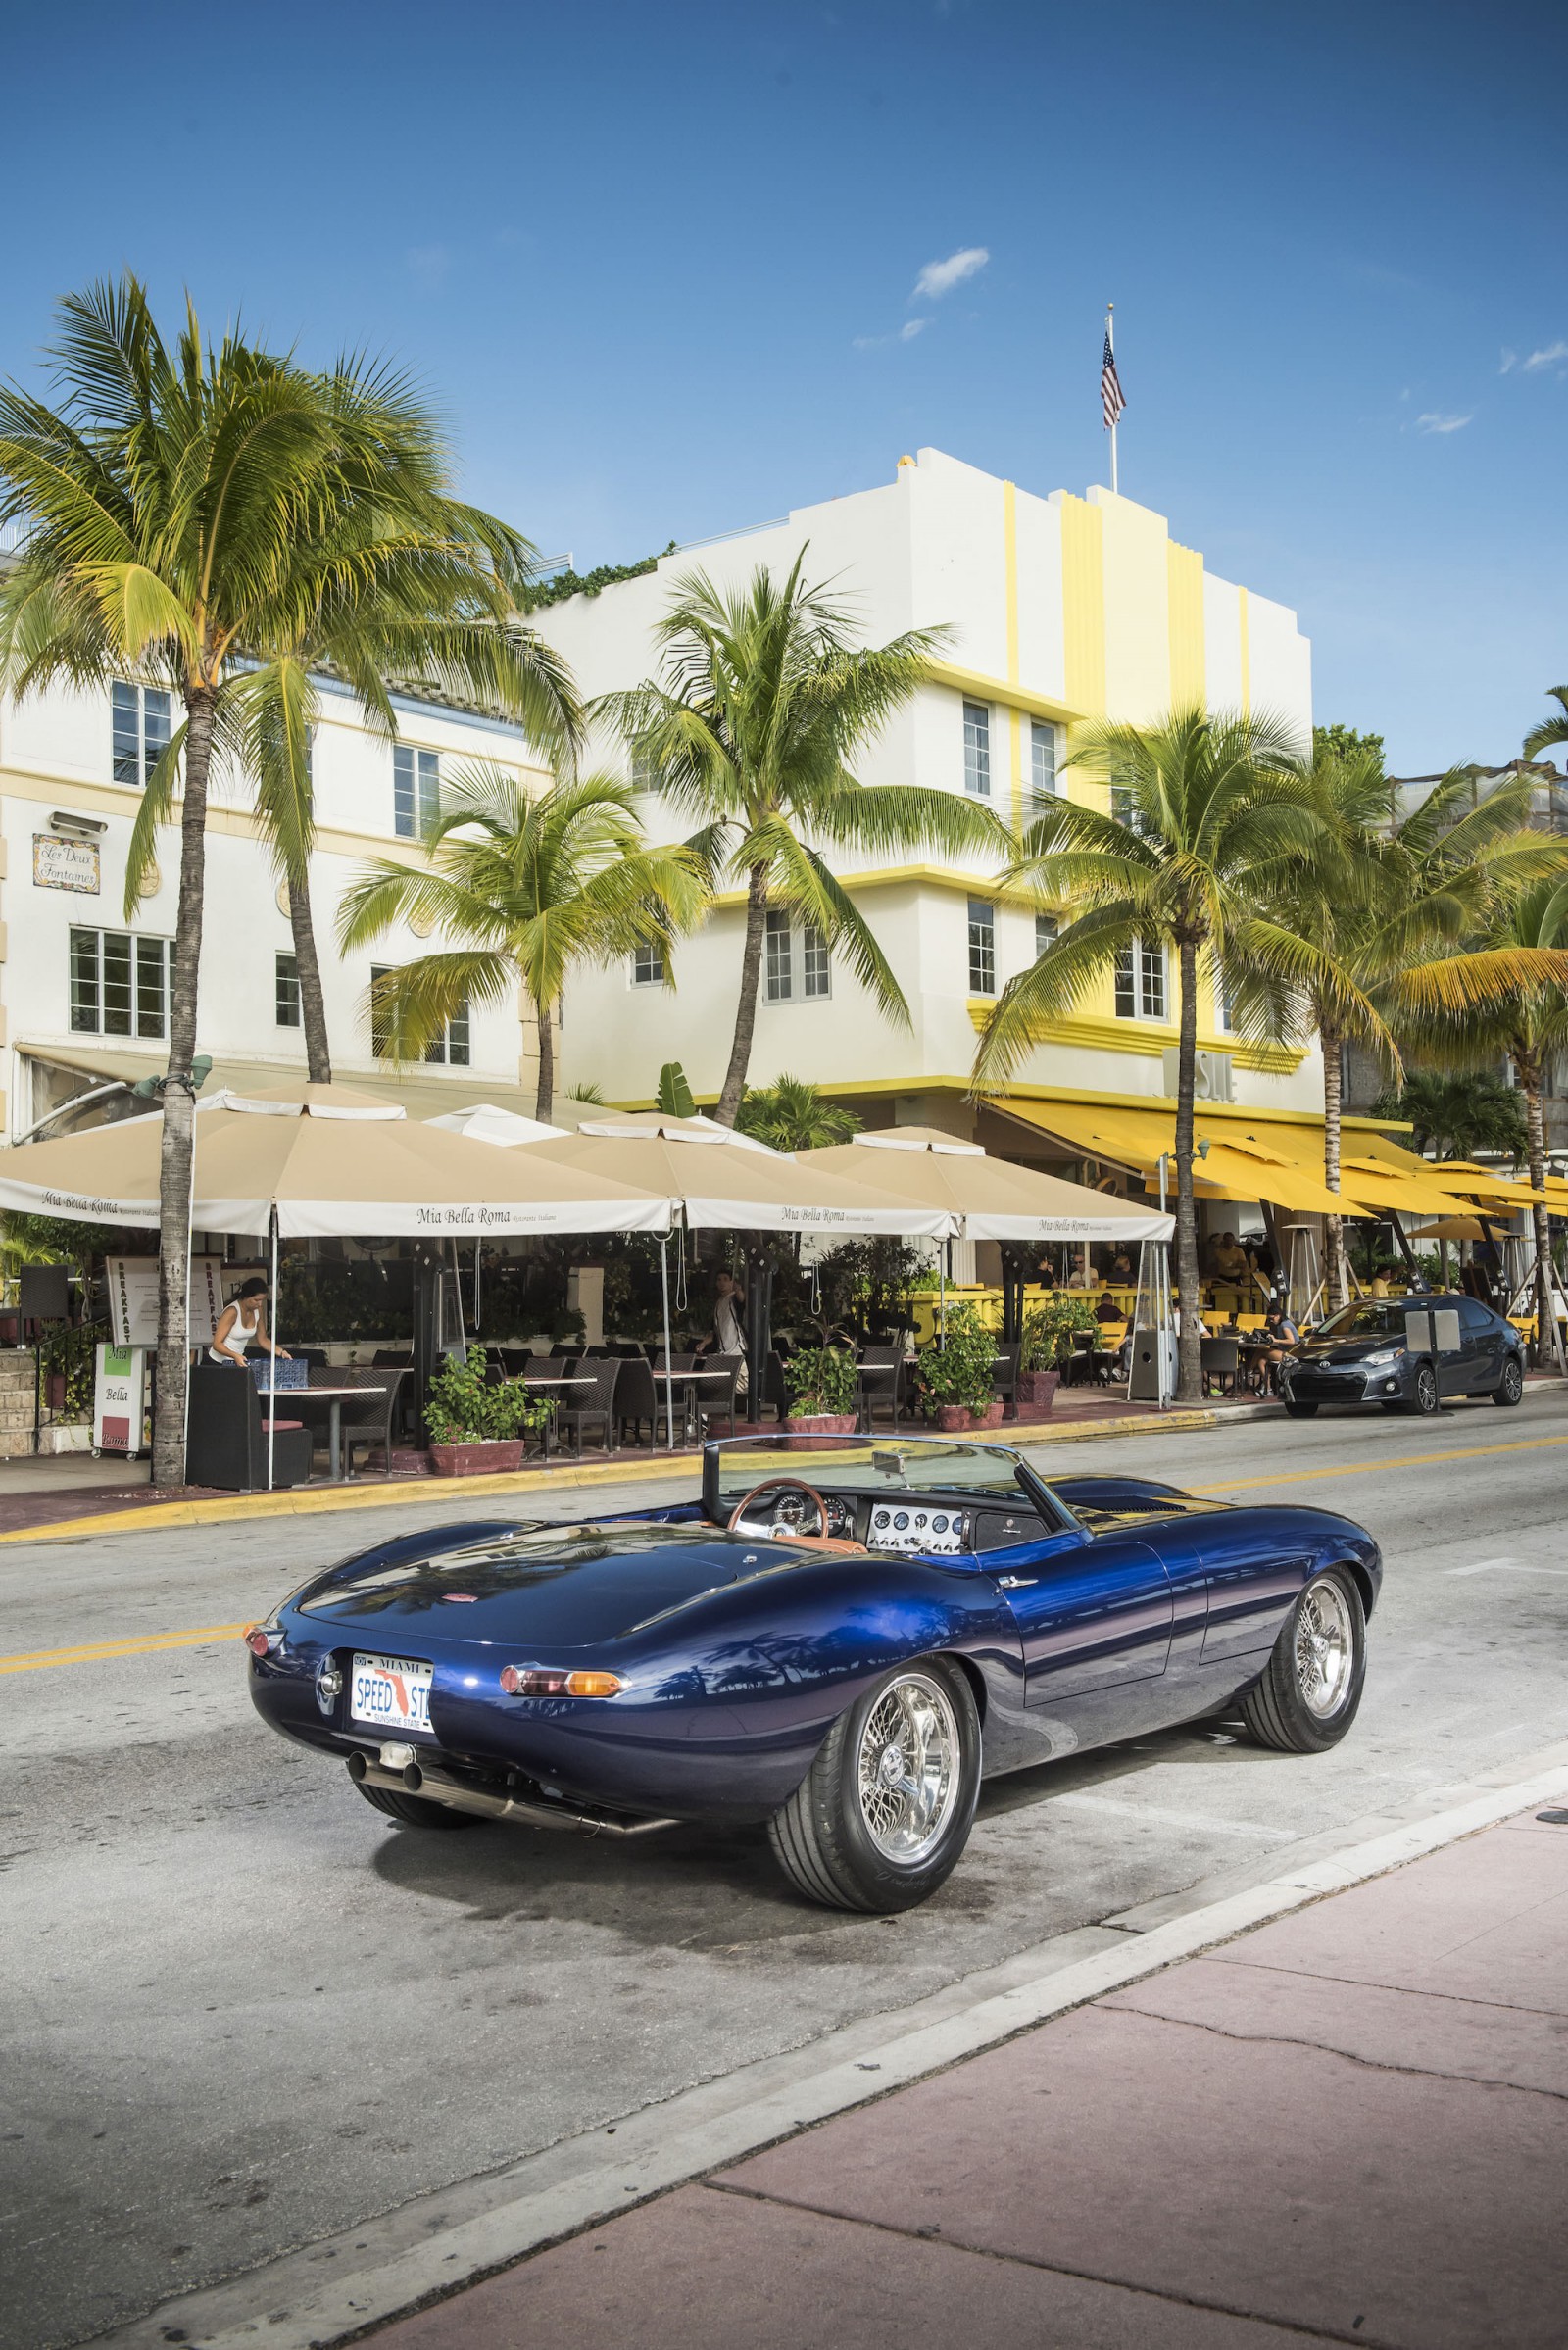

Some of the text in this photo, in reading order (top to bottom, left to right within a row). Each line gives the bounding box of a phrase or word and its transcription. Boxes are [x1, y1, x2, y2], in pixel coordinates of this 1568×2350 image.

[42, 845, 90, 863] Les Deux
[41, 863, 94, 883] Fontaines
[41, 1192, 61, 1206] Mia
[64, 1197, 87, 1210] Bella
[89, 1199, 117, 1215] Roma
[416, 1207, 442, 1224] Mia
[445, 1207, 475, 1224] Bella
[478, 1208, 510, 1226] Roma
[782, 1207, 799, 1220] Mia
[802, 1207, 821, 1221] Bella
[823, 1209, 845, 1223] Roma
[1039, 1219, 1053, 1231] Mia
[1054, 1219, 1070, 1231] Bella
[1072, 1220, 1090, 1233] Roma
[118, 1262, 131, 1344] BREAKFAST
[108, 1346, 127, 1360] Mia
[106, 1387, 128, 1401] Bella
[102, 1433, 129, 1447] Roma
[379, 1659, 419, 1673] MIAMI
[357, 1678, 392, 1712] SPEED
[374, 1714, 420, 1729] SUNSHINE STATE
